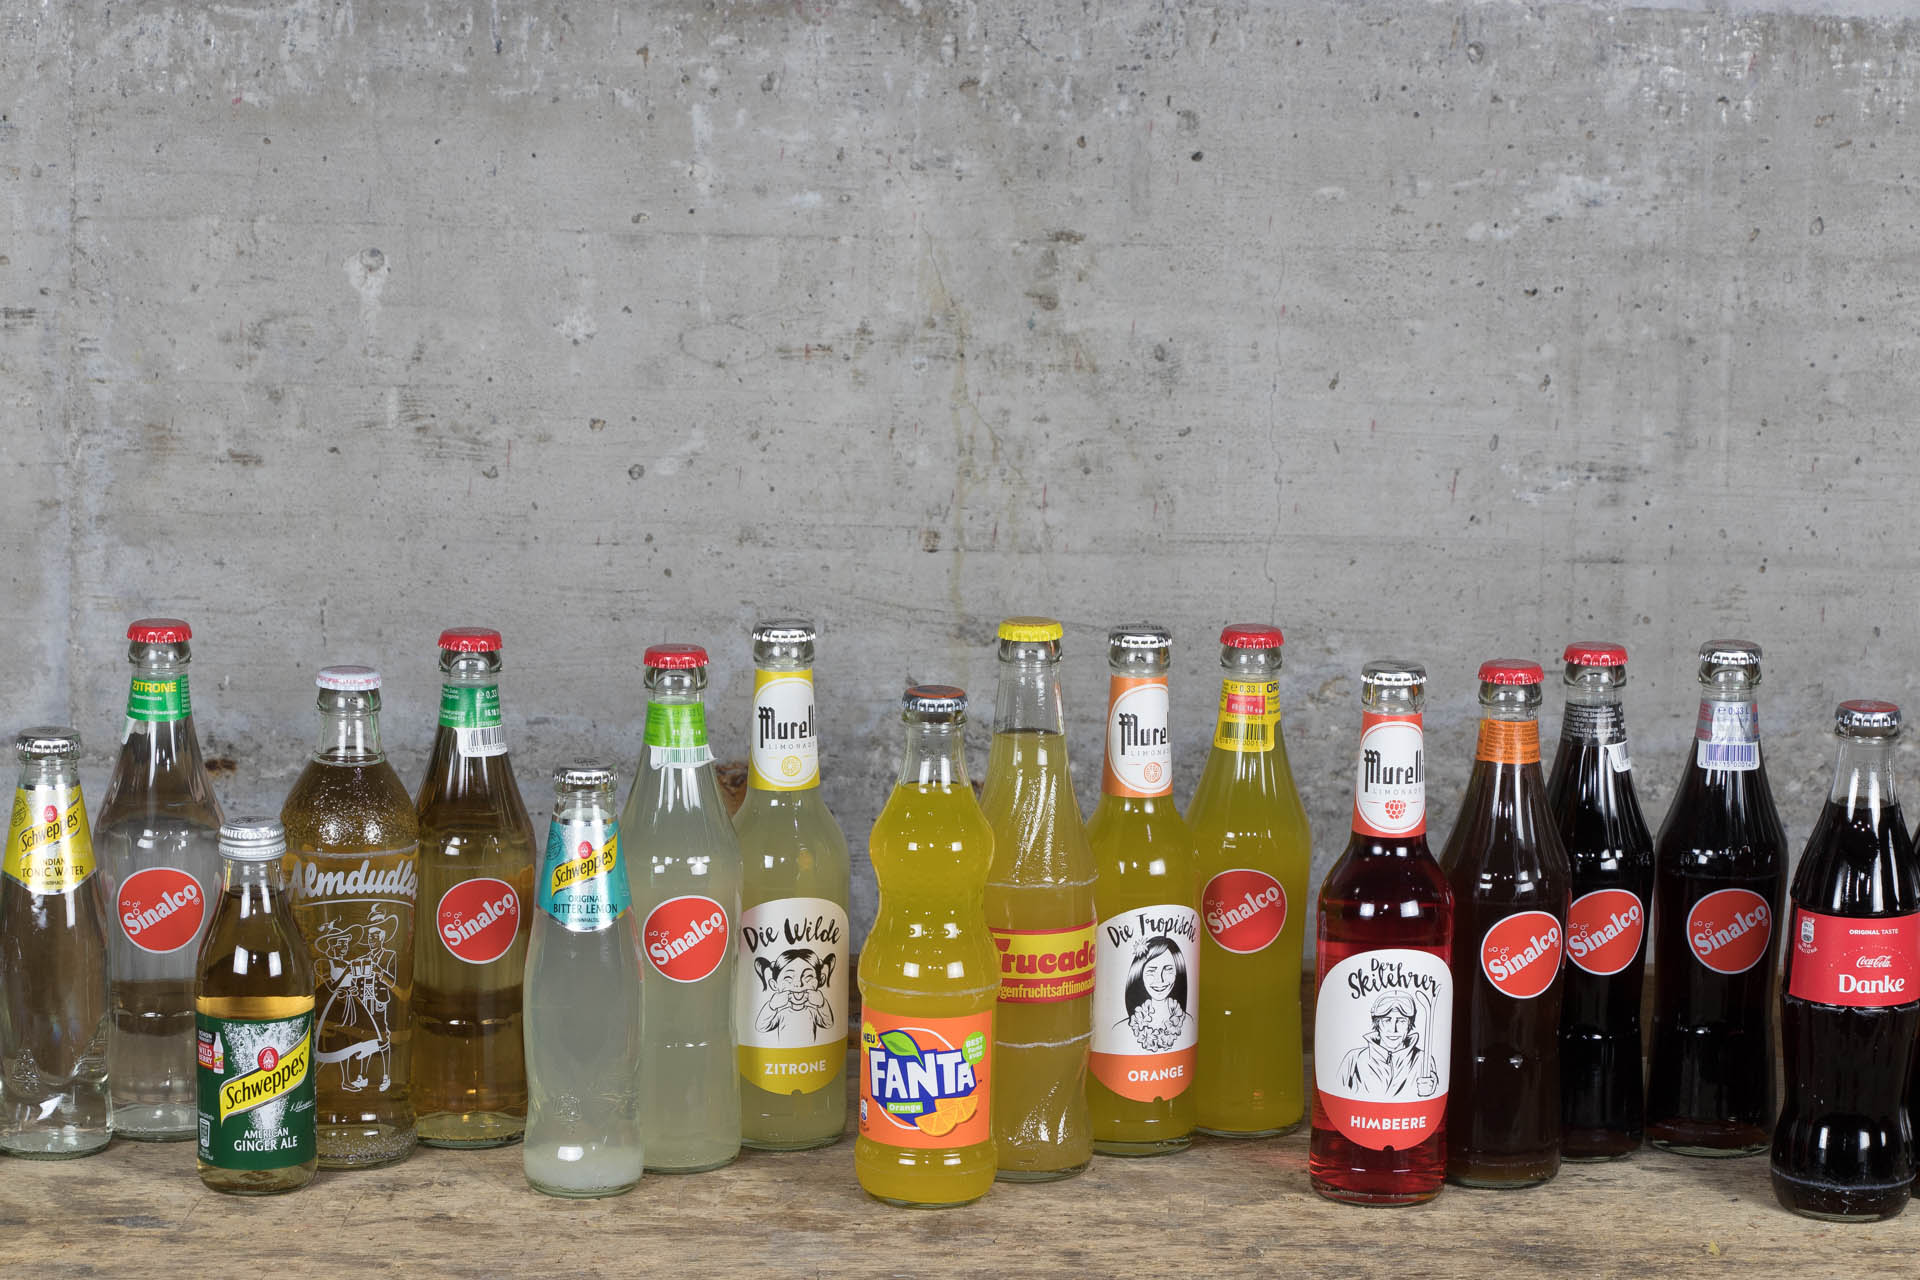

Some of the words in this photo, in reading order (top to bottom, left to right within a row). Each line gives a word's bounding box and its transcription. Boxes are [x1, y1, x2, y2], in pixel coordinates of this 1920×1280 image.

[132, 680, 177, 693] ZITRONE
[758, 703, 817, 749] Murell
[21, 810, 79, 852] Schweppes
[42, 858, 66, 866] NDIAN
[54, 865, 84, 877] WTER
[554, 848, 613, 888] Schweppes
[123, 884, 197, 935] Sinalco
[443, 893, 514, 946] Sinalco
[553, 903, 583, 914] BITTER
[1207, 886, 1279, 934] Sinalco
[650, 912, 722, 966] Sinalco
[742, 926, 779, 953] Die
[784, 915, 840, 945] Wilde
[1107, 925, 1133, 949] Die
[1568, 905, 1639, 957] Sinalco
[1694, 905, 1766, 955] Sinalco
[1371, 957, 1395, 972] Der
[1488, 927, 1558, 982] Sinalco
[1348, 962, 1441, 1000] Skilehrer
[1838, 973, 1905, 994] Danke
[863, 1031, 876, 1044] NEU
[226, 1051, 305, 1110] Schweppes
[764, 1059, 827, 1075] ZITRONE
[869, 1050, 975, 1099] FANTA
[1127, 1064, 1184, 1082] ORANGE
[888, 1103, 921, 1113] Orange
[1350, 1115, 1427, 1130] HIMBEERE
[233, 1139, 278, 1152] GINGER
[280, 1135, 298, 1150] ALE
[243, 1126, 289, 1139] AMERICAN
